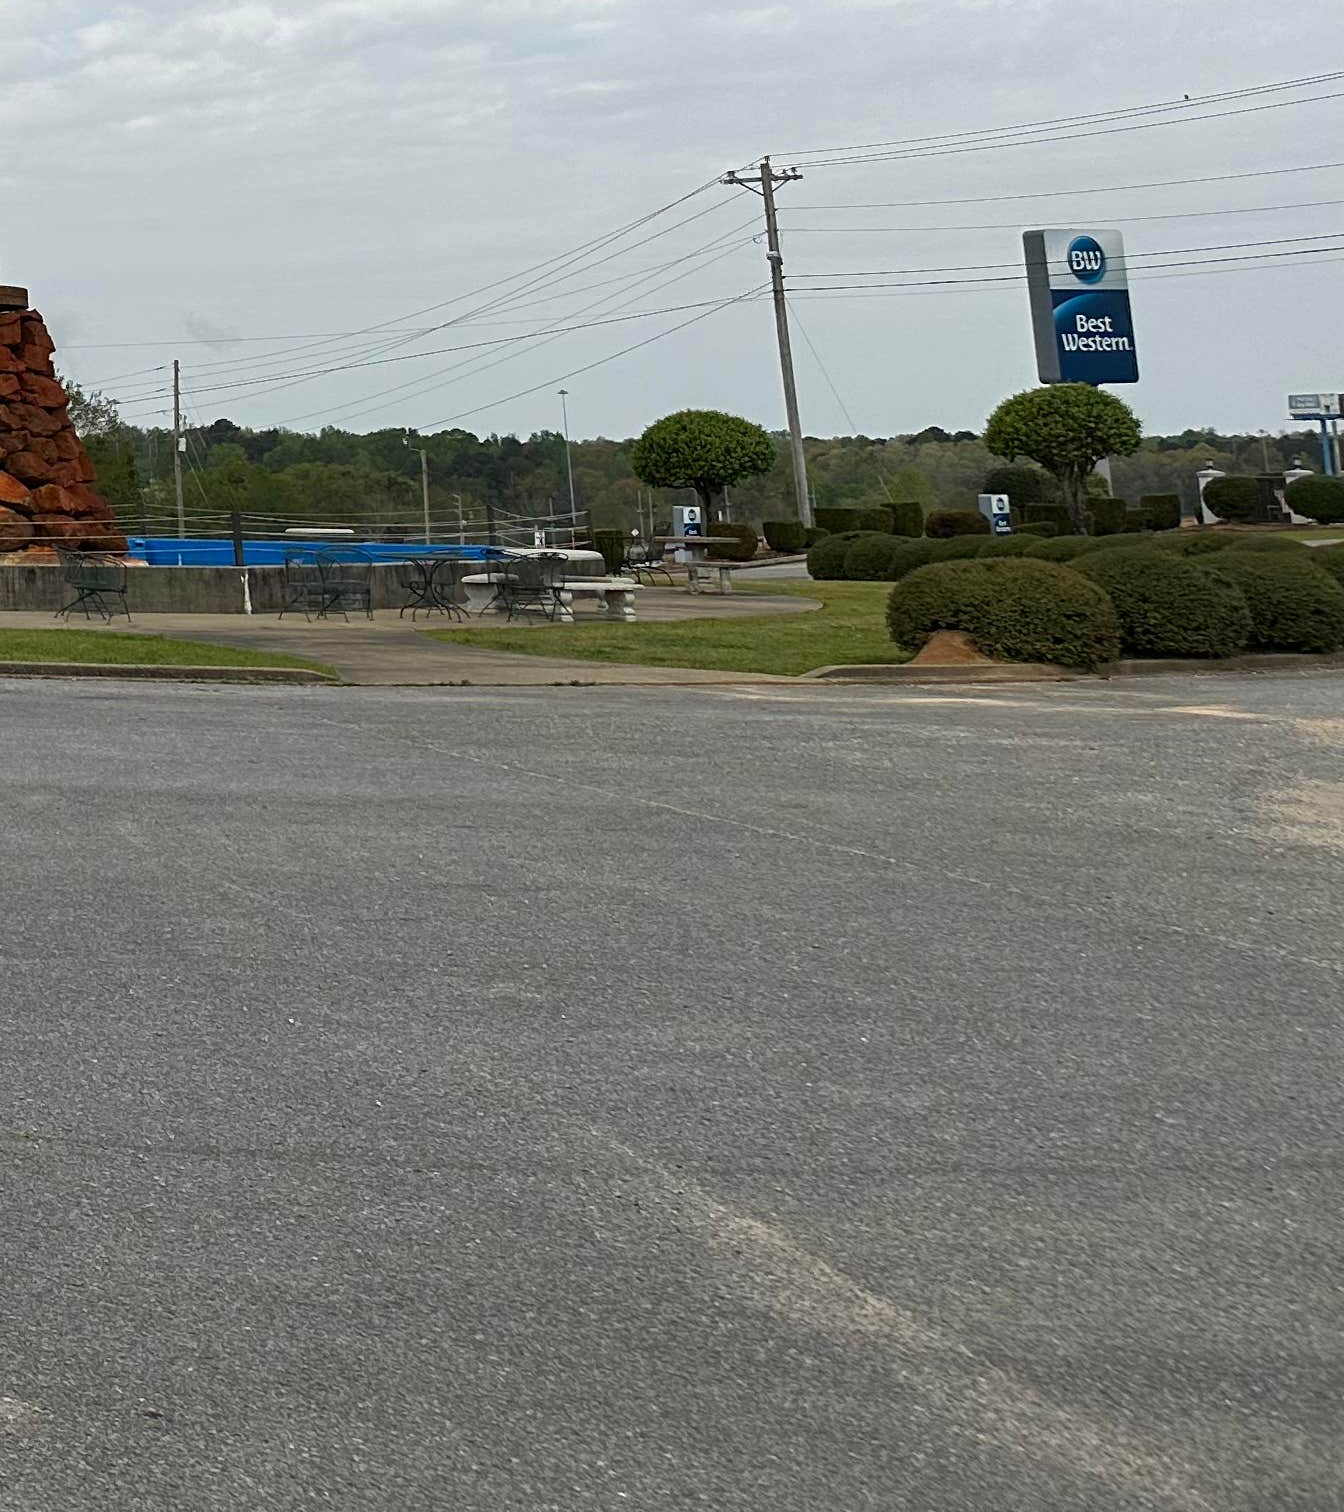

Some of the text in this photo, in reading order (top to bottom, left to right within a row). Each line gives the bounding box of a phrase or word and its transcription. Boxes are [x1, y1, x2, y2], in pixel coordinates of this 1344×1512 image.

[1071, 250, 1101, 271] BW
[1076, 314, 1113, 333] Best
[1062, 333, 1129, 351] Western
